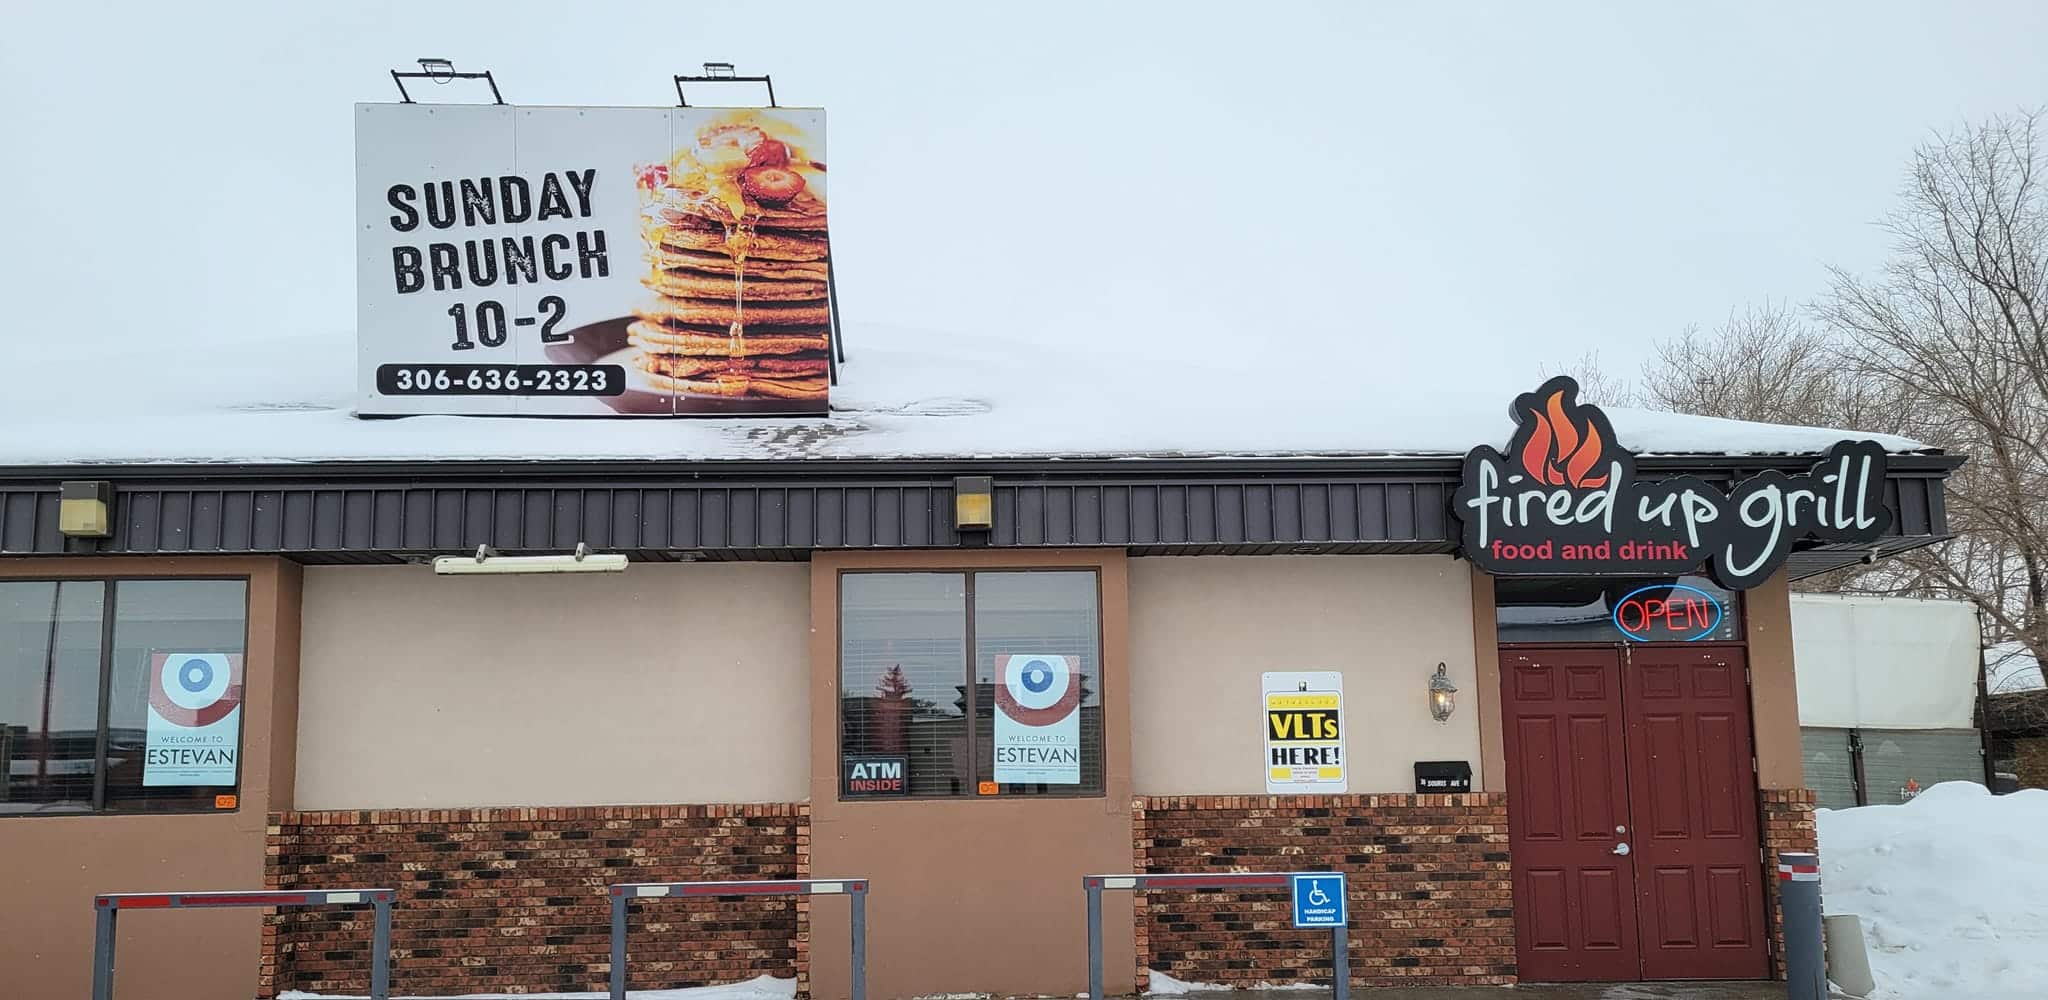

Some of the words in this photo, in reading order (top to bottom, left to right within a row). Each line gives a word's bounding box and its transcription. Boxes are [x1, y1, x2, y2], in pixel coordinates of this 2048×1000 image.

[387, 169, 597, 232] SUNDAY
[392, 230, 609, 295] BRUNCH
[447, 295, 571, 351] 10-2
[396, 368, 608, 392] 306-636-2323
[1467, 458, 1623, 549] fired
[1637, 488, 1719, 549] up
[1725, 454, 1876, 577] grill
[1491, 540, 1553, 561] food
[1561, 540, 1611, 561] and
[1620, 540, 1689, 561] drink
[1619, 598, 1709, 632] OPEN
[1270, 713, 1338, 739] VLTs
[212, 735, 224, 743] TO
[1008, 735, 1052, 743] WELCOME
[1055, 735, 1067, 743] TO
[147, 749, 234, 765] ESTEVAN
[997, 747, 1077, 763] ESTEVAN
[1271, 747, 1340, 765] HERE!
[851, 762, 901, 779] ATM
[850, 780, 901, 791] INSIDE
